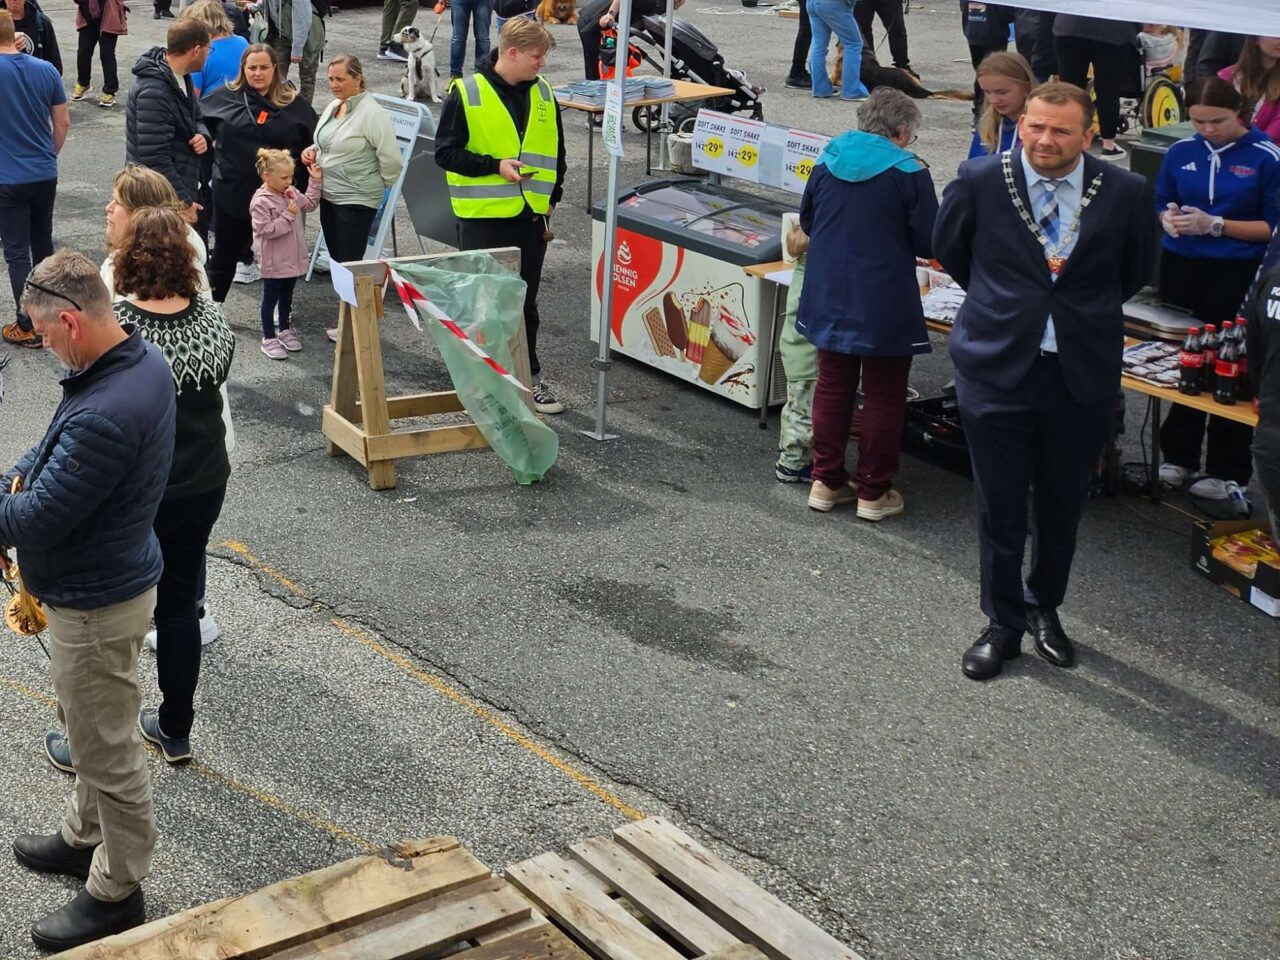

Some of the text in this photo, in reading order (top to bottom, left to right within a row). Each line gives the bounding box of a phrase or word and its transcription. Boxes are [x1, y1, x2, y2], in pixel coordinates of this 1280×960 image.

[697, 120, 710, 129] SOFT
[710, 123, 727, 133] SHAKE
[730, 127, 743, 137] SOFT
[743, 131, 761, 141] SHAKE
[787, 140, 801, 150] SOFT
[801, 143, 820, 155] SHAKE
